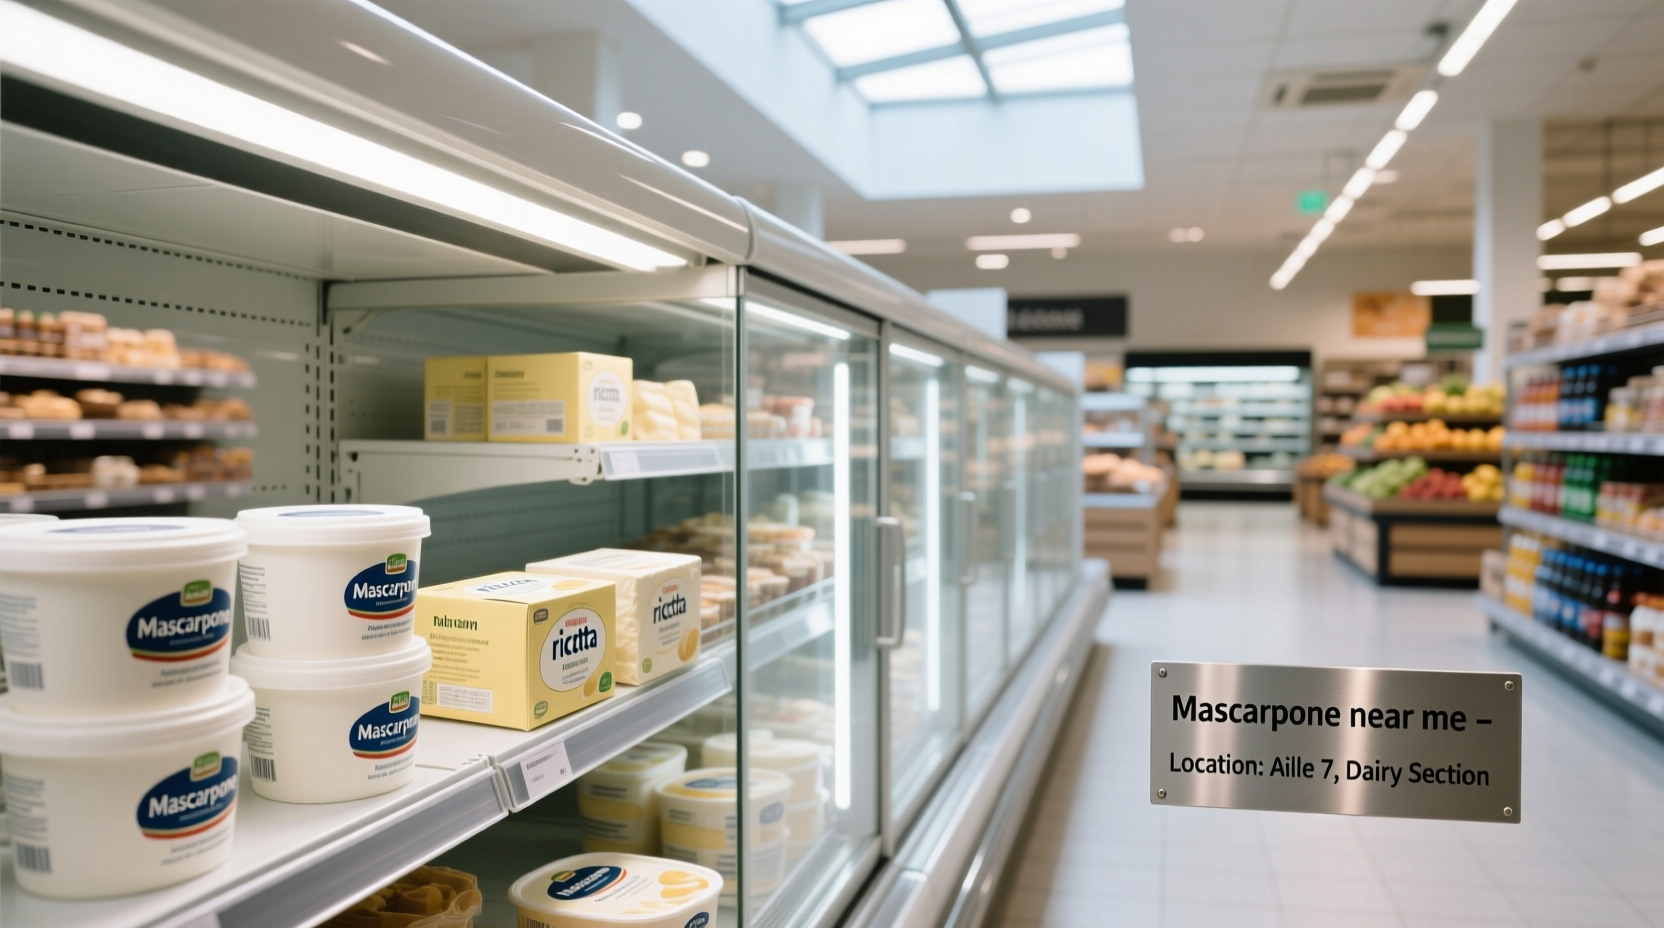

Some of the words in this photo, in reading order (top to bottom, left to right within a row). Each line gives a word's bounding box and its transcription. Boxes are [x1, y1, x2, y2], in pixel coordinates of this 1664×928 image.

[1171, 694, 1341, 732] Mascarpone
[1350, 705, 1415, 731] near
[1421, 709, 1467, 732] me
[1169, 751, 1265, 777] Location:
[1269, 755, 1315, 779] Aille
[1320, 758, 1340, 785] 7,
[1346, 759, 1403, 789] Dairy
[1407, 762, 1490, 787] Section
